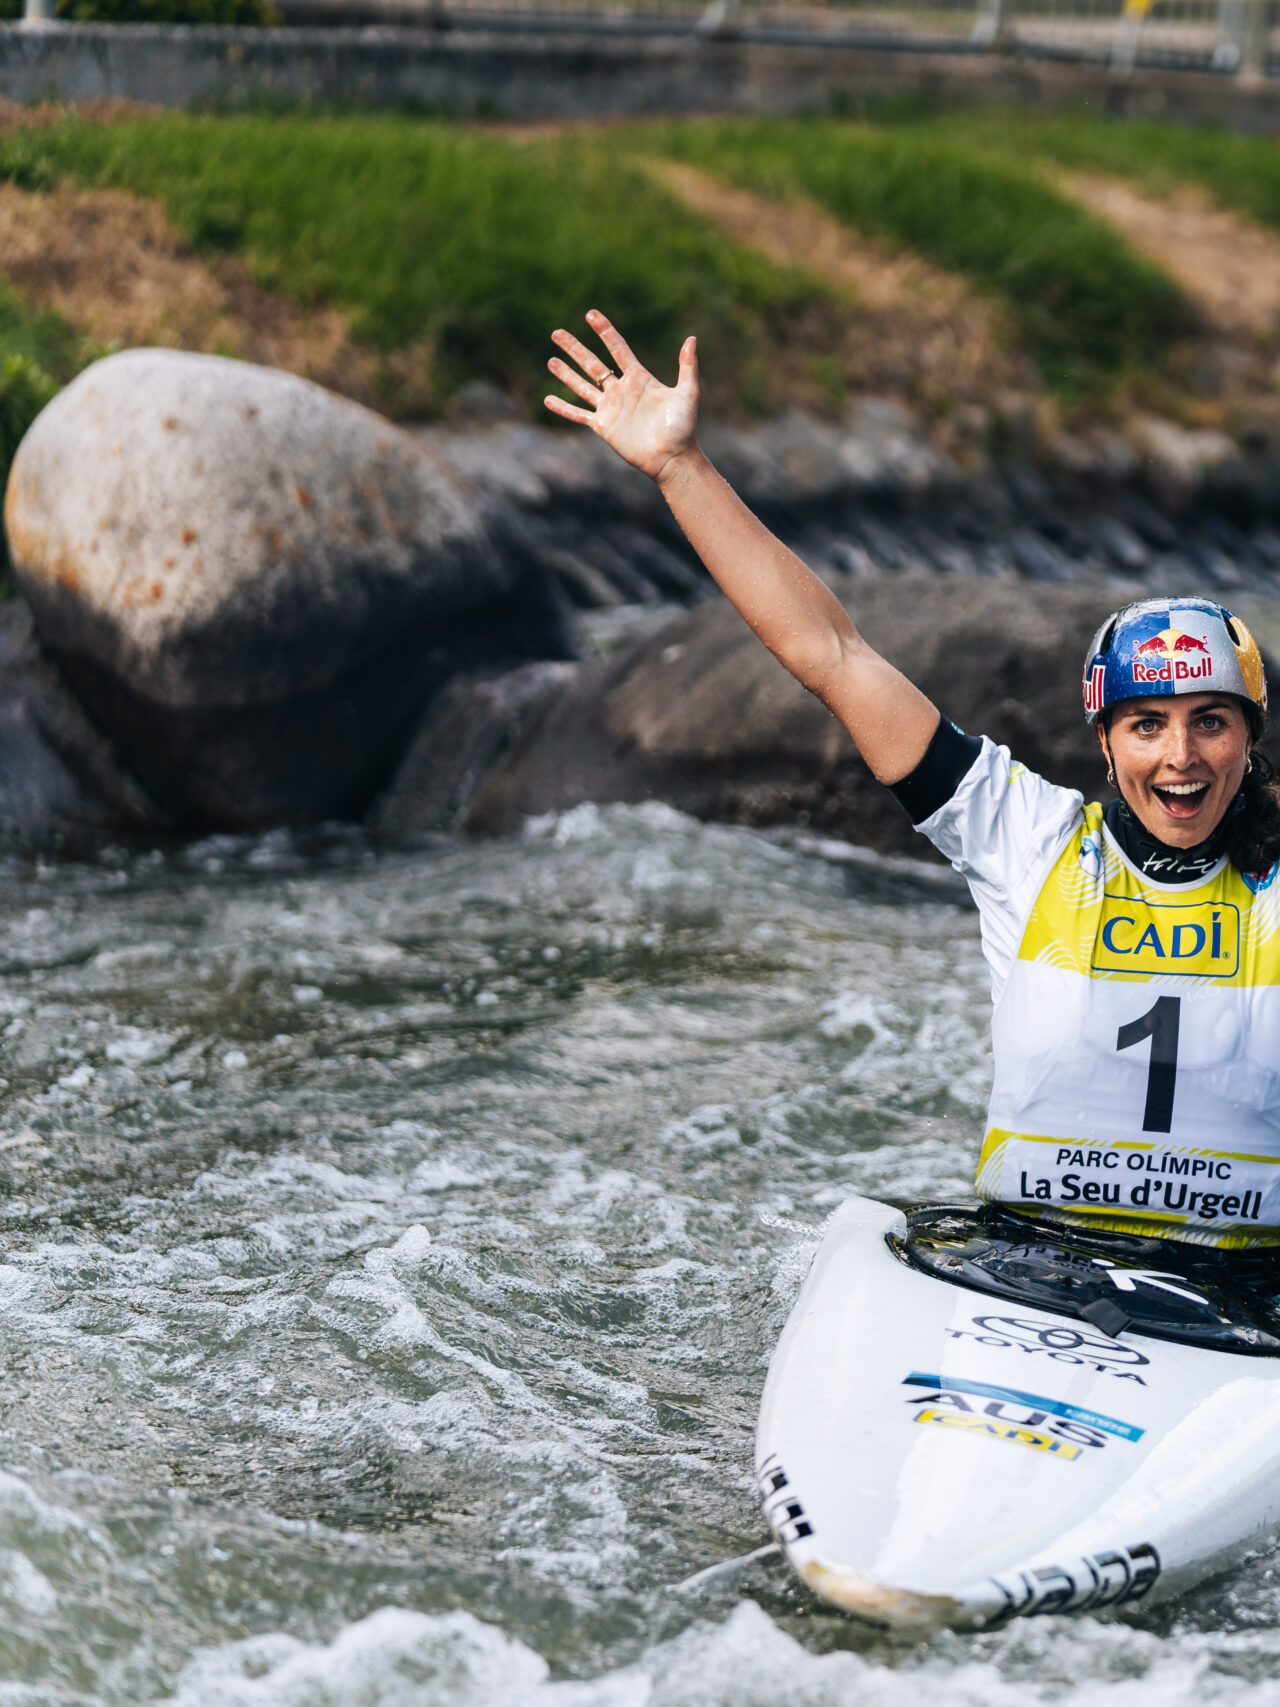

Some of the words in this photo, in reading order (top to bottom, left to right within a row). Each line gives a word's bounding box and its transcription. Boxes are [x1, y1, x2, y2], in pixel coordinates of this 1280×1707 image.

[1083, 664, 1105, 711] ull
[1133, 661, 1172, 682] Red
[1175, 657, 1212, 679] Bull
[1116, 995, 1181, 1134] 1
[1020, 1171, 1052, 1199] La
[1060, 1174, 1121, 1203] Seu
[1056, 1148, 1120, 1169] PARC
[1126, 1152, 1232, 1180] OLÍMPIC
[945, 1328, 1148, 1386] TOYOTA
[905, 1393, 1108, 1448] AUS
